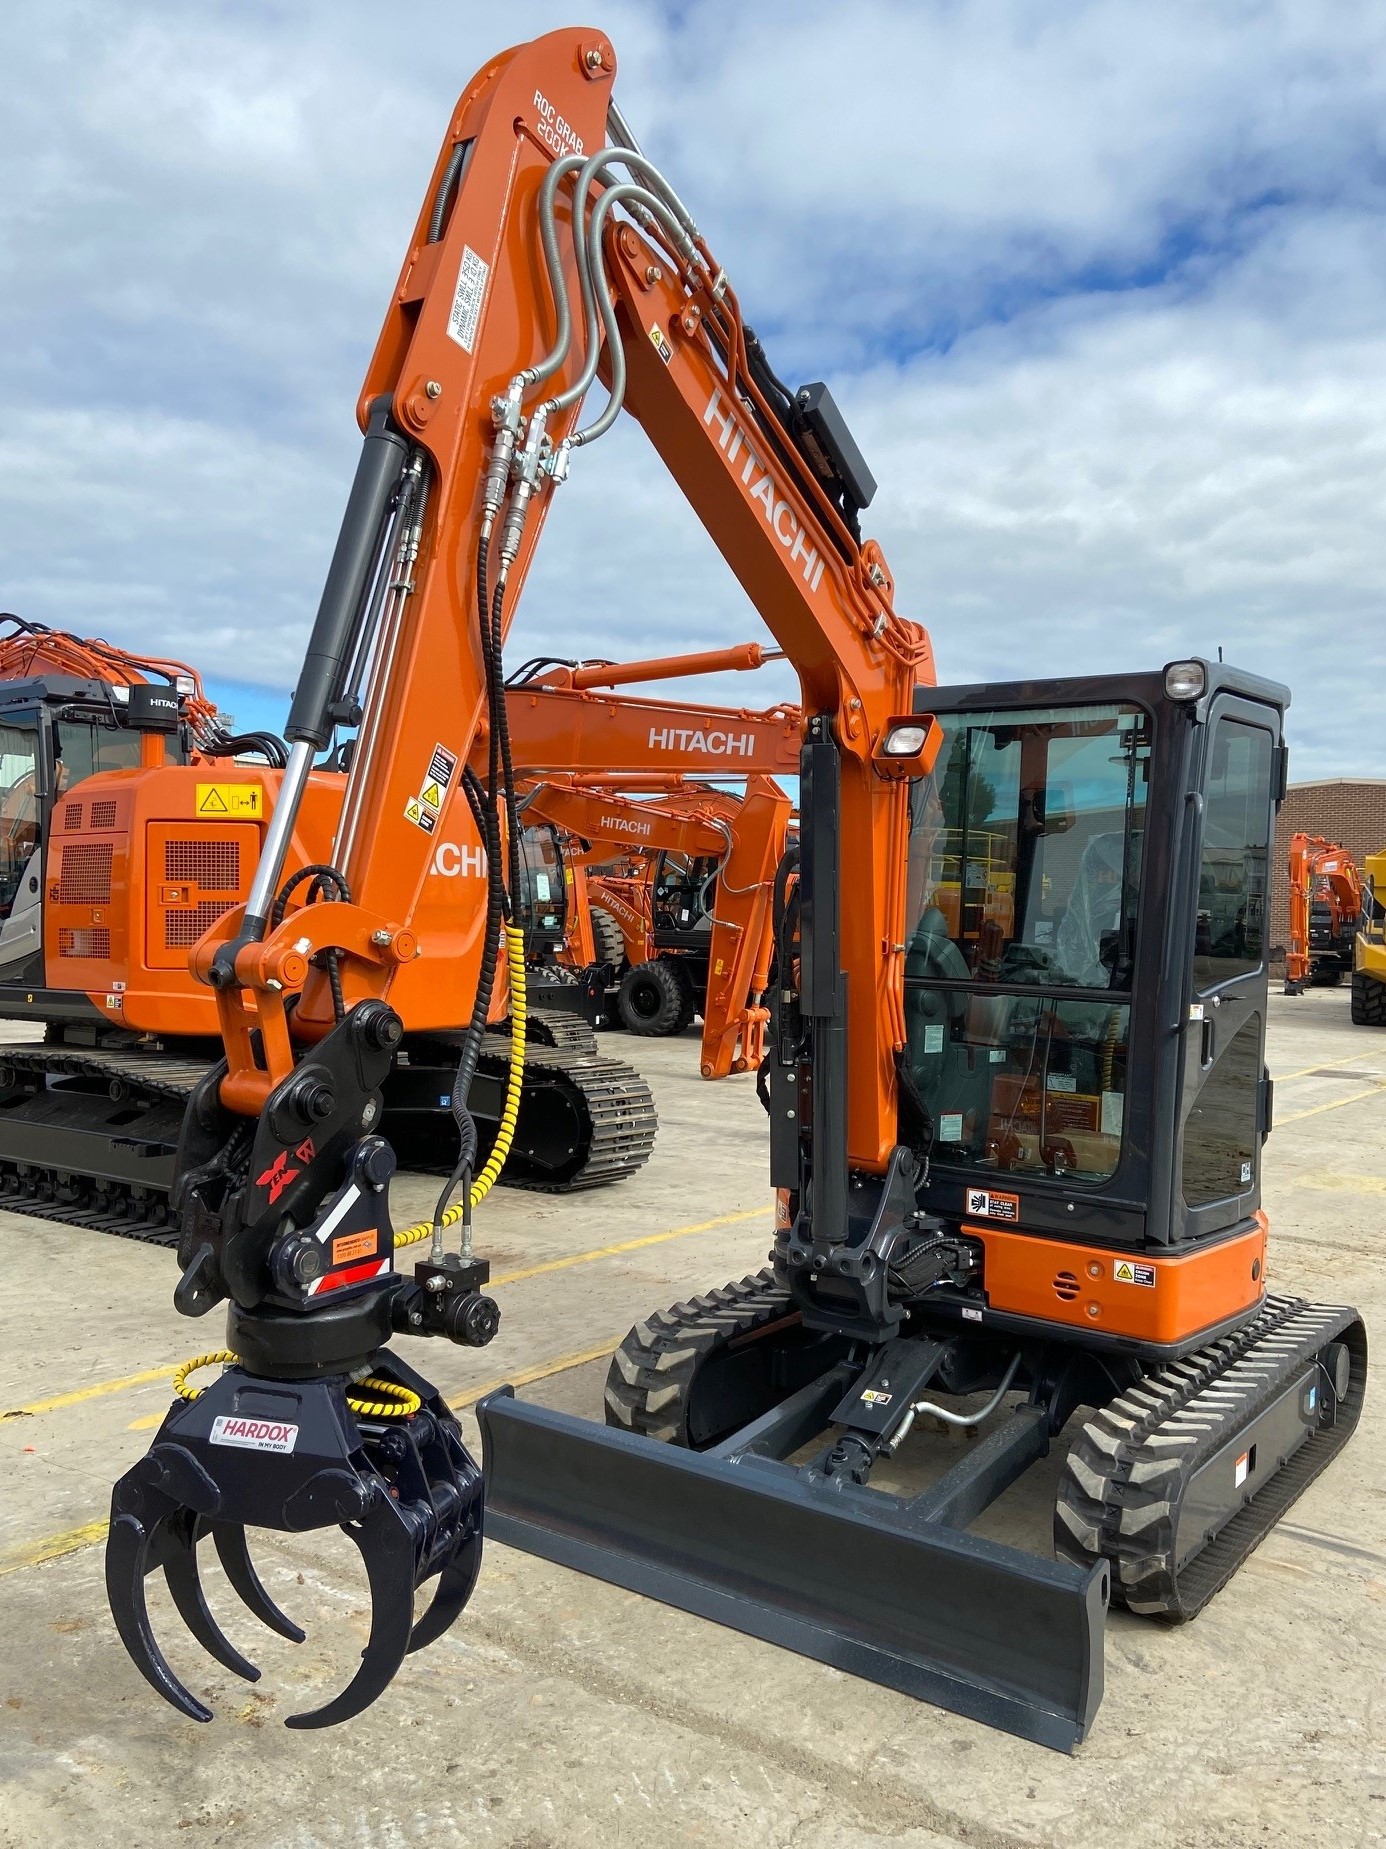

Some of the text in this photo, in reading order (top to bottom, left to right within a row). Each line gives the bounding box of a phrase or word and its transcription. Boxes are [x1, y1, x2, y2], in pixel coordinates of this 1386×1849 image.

[533, 89, 584, 155] ROC GRAB
[452, 298, 463, 326] STATIC
[465, 249, 473, 263] KG
[457, 305, 470, 340] DYNAMIC
[472, 255, 480, 270] KG
[703, 387, 825, 593] HITACHI
[150, 698, 178, 709] HITAC
[648, 727, 755, 756] HITACHI
[601, 815, 650, 835] HITACHI
[601, 892, 634, 923] HITACHI
[222, 1419, 293, 1443] HARDOX
